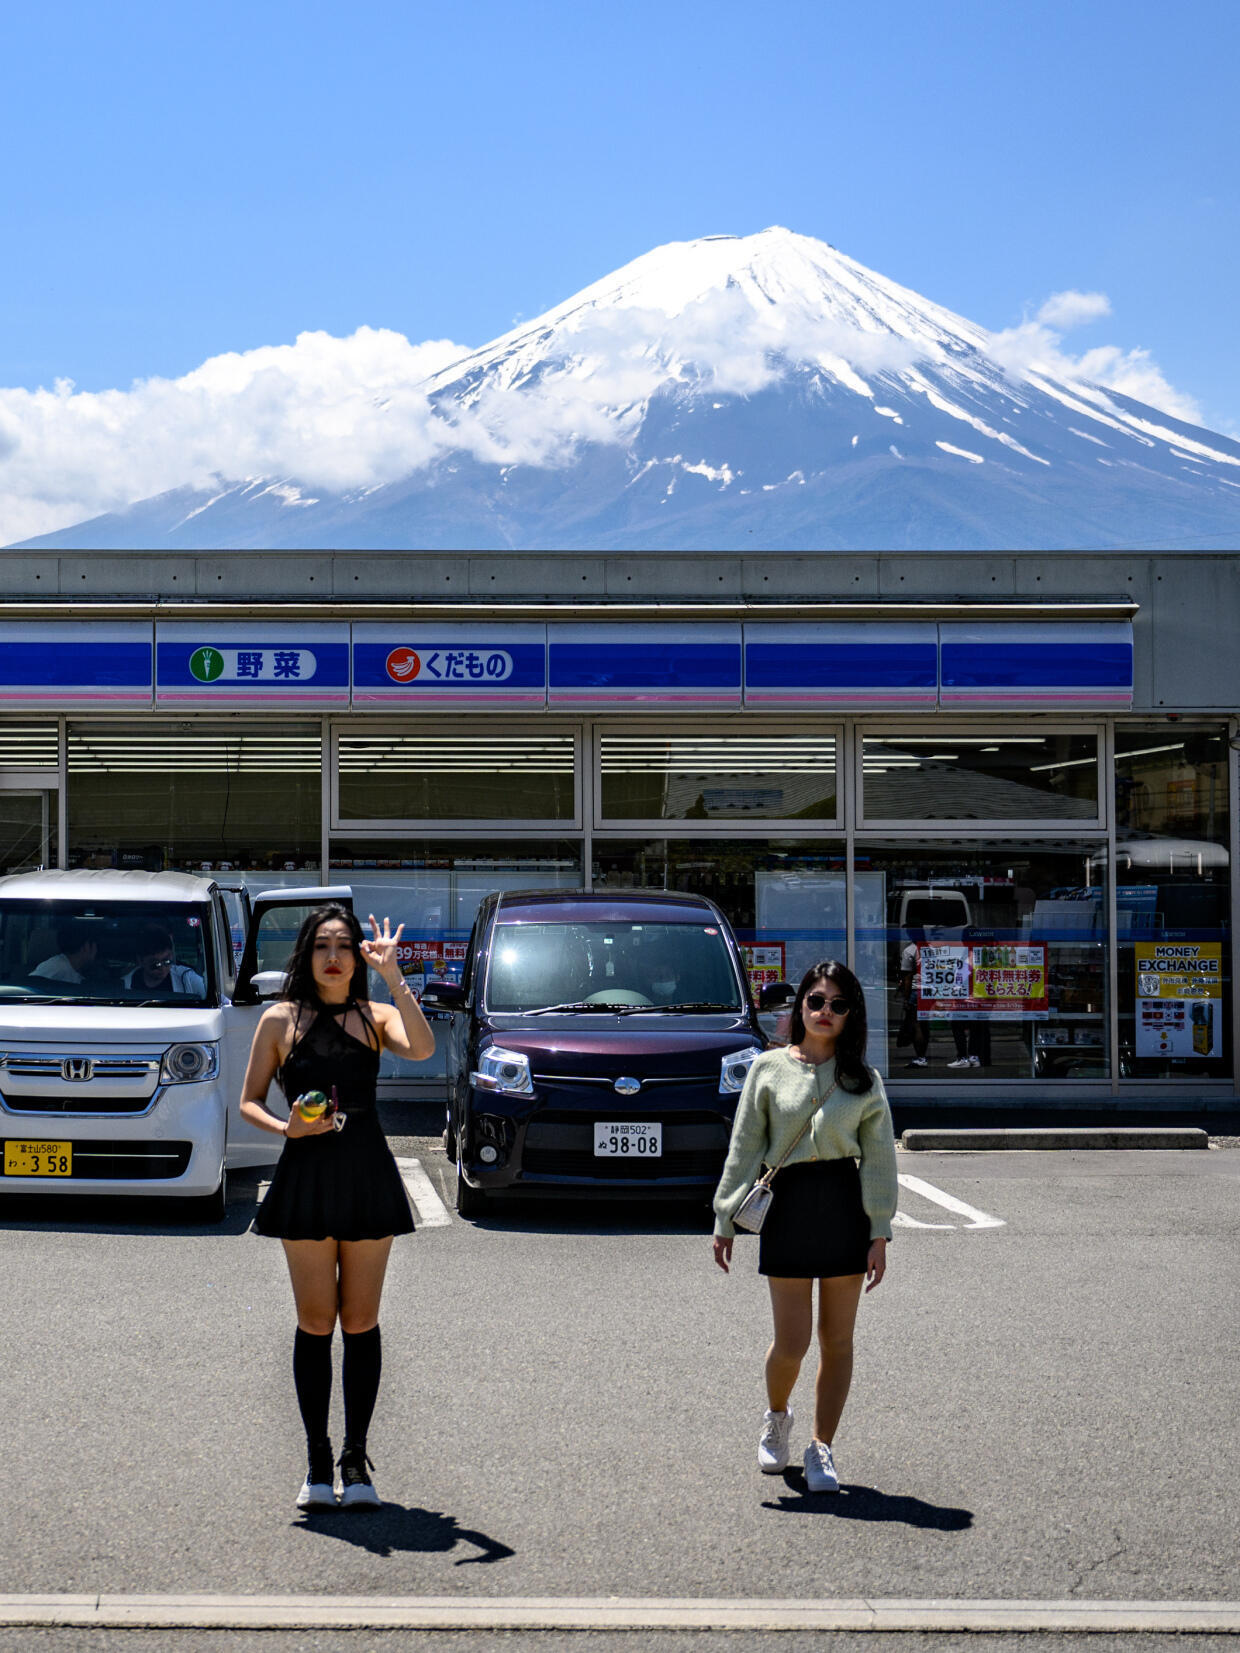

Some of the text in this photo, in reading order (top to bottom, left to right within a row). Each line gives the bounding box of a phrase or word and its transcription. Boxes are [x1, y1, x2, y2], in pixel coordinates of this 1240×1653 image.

[237, 652, 300, 678] 野菜
[426, 652, 506, 678] くだもの
[1156, 947, 1199, 957] MONEY
[1138, 960, 1217, 971] EXCHANGE
[609, 1136, 658, 1154] 98-08
